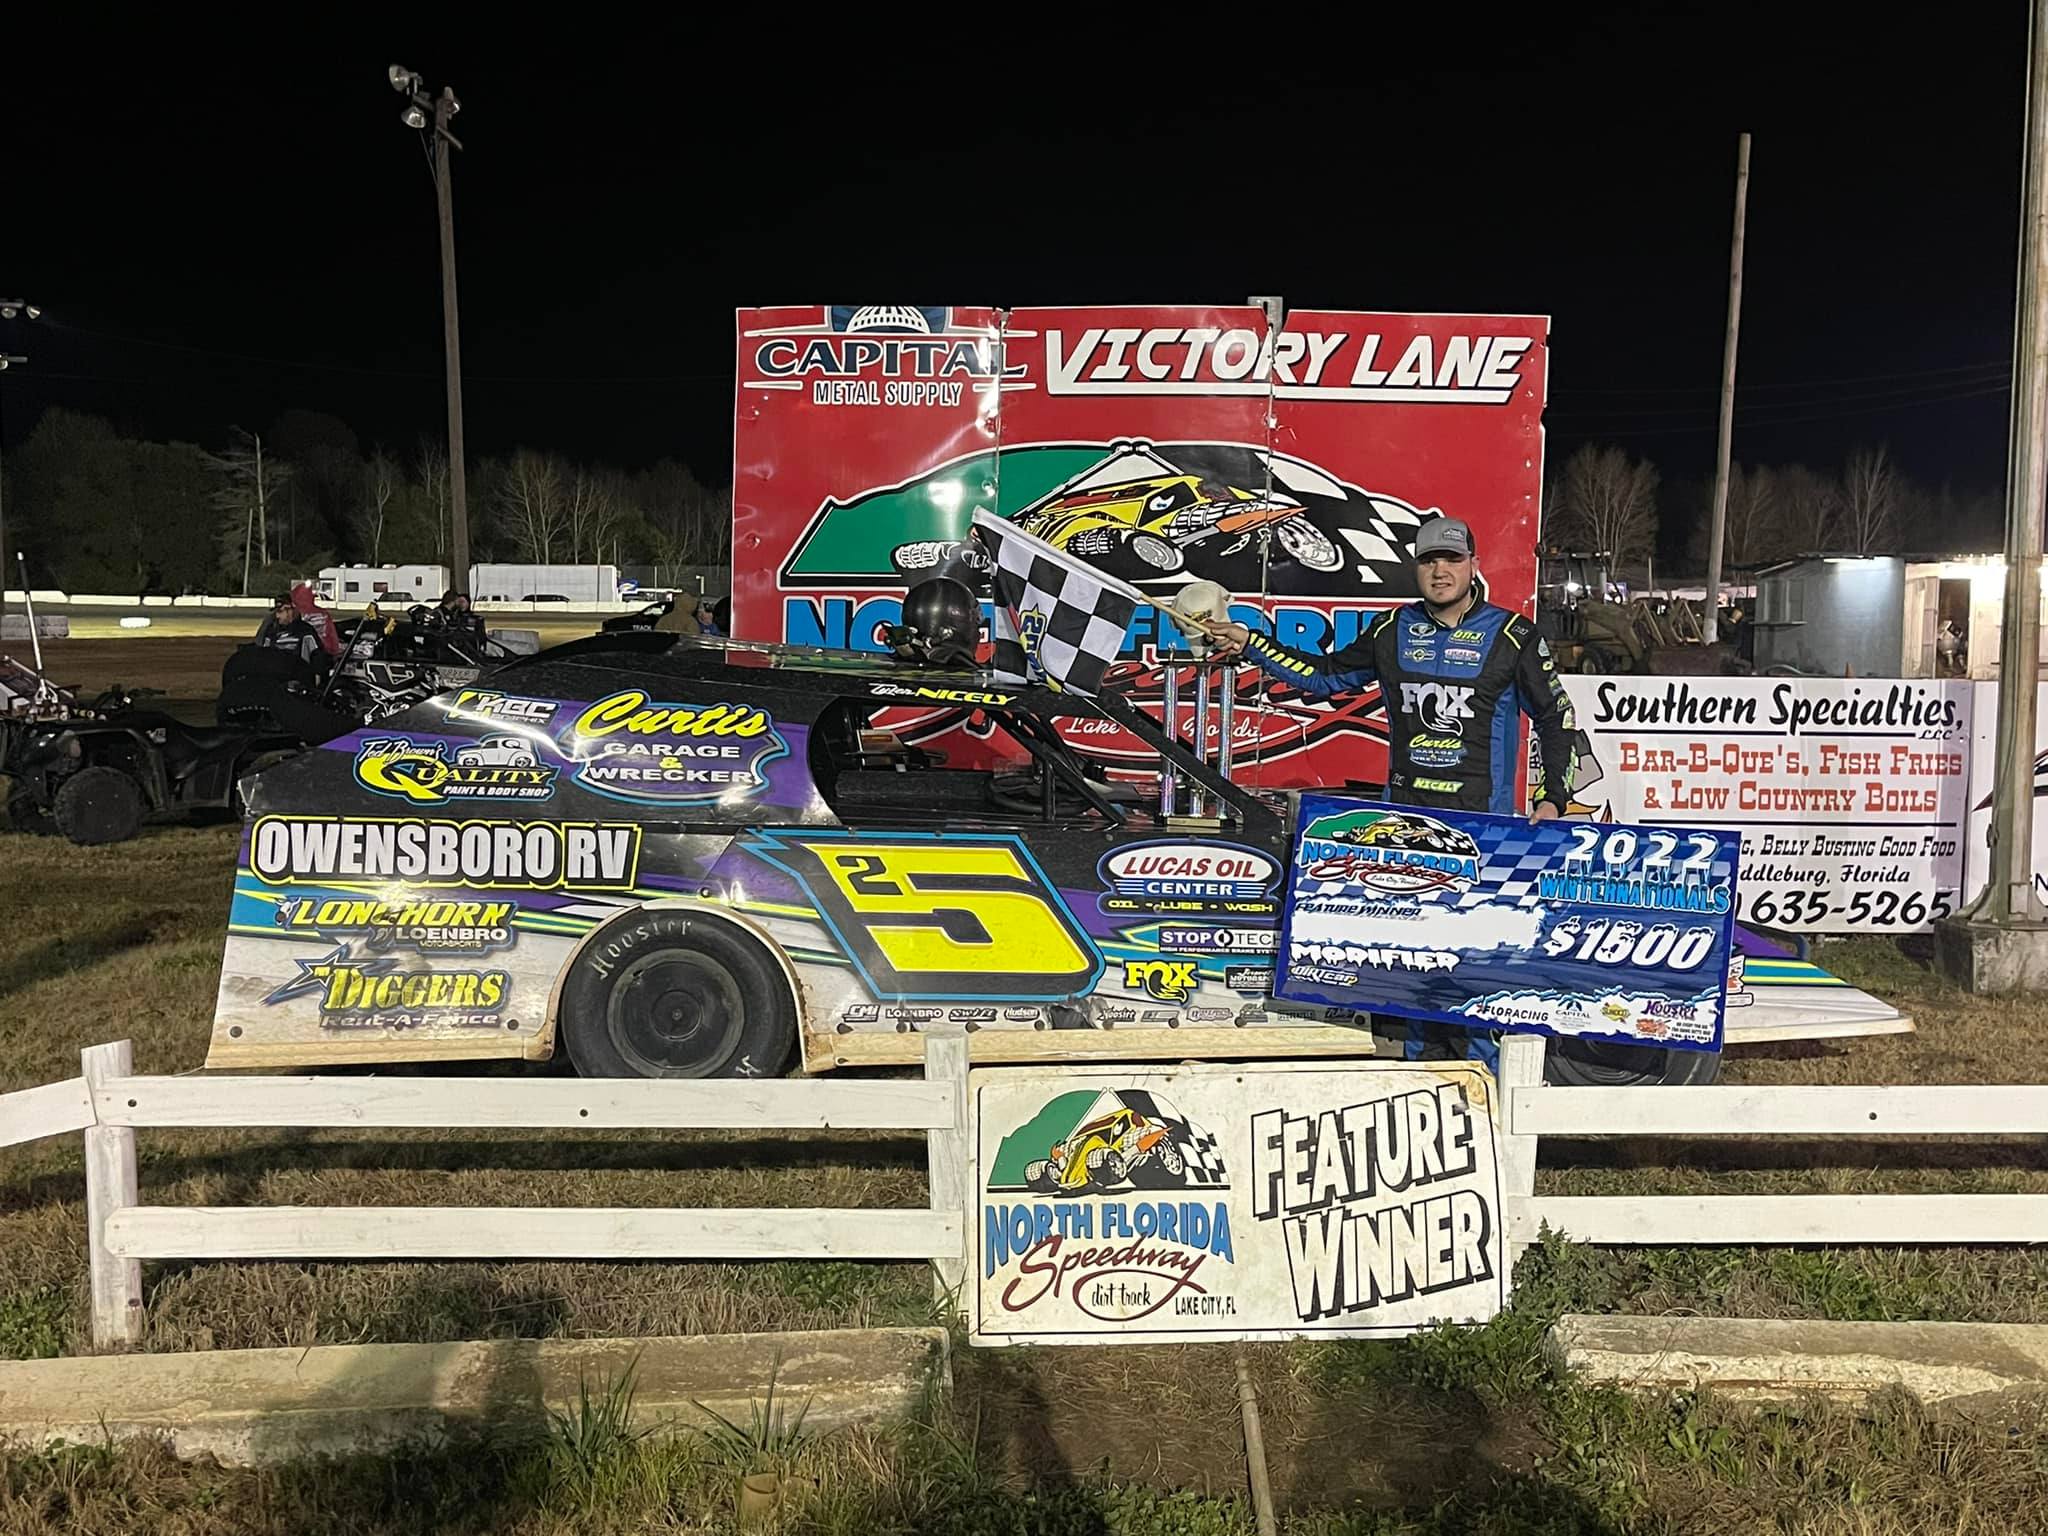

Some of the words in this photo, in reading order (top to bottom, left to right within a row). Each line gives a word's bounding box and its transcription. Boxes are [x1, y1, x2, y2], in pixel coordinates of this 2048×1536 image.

[756, 339, 1027, 378] CAPITAL
[1046, 328, 1348, 394] VICTORY
[1351, 333, 1534, 388] LANE
[814, 381, 881, 405] METAL
[885, 382, 963, 406] SUPPLY
[915, 687, 1018, 704] NICELY
[1400, 682, 1475, 736] FOX
[1594, 681, 1756, 724] Southern
[1769, 683, 1963, 736] Specialties,
[575, 692, 767, 737] Curtis
[1064, 717, 1120, 734] Lake
[603, 743, 740, 758] GARAGE
[659, 756, 683, 769] &
[1820, 744, 1881, 775] FISH
[1890, 745, 1962, 776] FRIES
[360, 753, 553, 799] QUALITY
[443, 785, 477, 794] PAINT
[477, 786, 485, 795] &
[487, 787, 519, 796] BODY
[519, 788, 550, 797] SHOP
[588, 767, 755, 783] WRECKER
[1643, 786, 1662, 809] &
[1671, 780, 1730, 810] LOW
[1739, 780, 1856, 812] COUNTRY
[1864, 782, 1937, 812] BOILS
[257, 822, 556, 879] OWENSBORO
[567, 828, 630, 879] RV
[1302, 841, 1378, 866] NORTH
[1383, 849, 1478, 882] FLORIDA
[1565, 825, 1719, 872] 2022
[1760, 834, 1809, 856] BELLY
[1811, 835, 1877, 857] BUSTING
[1879, 836, 1916, 857] GOOD
[1919, 836, 1955, 857] FOOD
[835, 855, 904, 895] 2
[1123, 857, 1211, 877] LUCAS
[1216, 859, 1257, 878] OIL
[1739, 863, 1831, 887] ddleburg,
[1840, 864, 1910, 883] Florida
[1108, 899, 1139, 909] OIL
[1159, 901, 1203, 911] LUBE
[1147, 882, 1233, 896] CENTER
[1539, 871, 1732, 914] WINTERNATIONALS
[1750, 889, 1953, 925] 635-5265
[291, 900, 511, 926] LONGHORN
[801, 843, 1090, 975] 5
[396, 927, 508, 941] LOENBRO
[1543, 916, 1716, 970] $1500
[324, 969, 503, 1009] DIGGERS
[1126, 962, 1198, 1001] FOX
[1483, 1006, 1548, 1022] FLORACING
[1251, 1081, 1477, 1222] FEATURE
[985, 1203, 1093, 1279] NORTH
[1101, 1202, 1234, 1264] FLORIDA
[1282, 1190, 1495, 1322] WINNER
[1001, 1234, 1208, 1321] Speedway
[1091, 1282, 1116, 1306] dirt
[1117, 1283, 1152, 1306] track
[1175, 1297, 1199, 1315] LAKE
[1201, 1296, 1226, 1318] CITY,
[1226, 1296, 1237, 1315] FL
